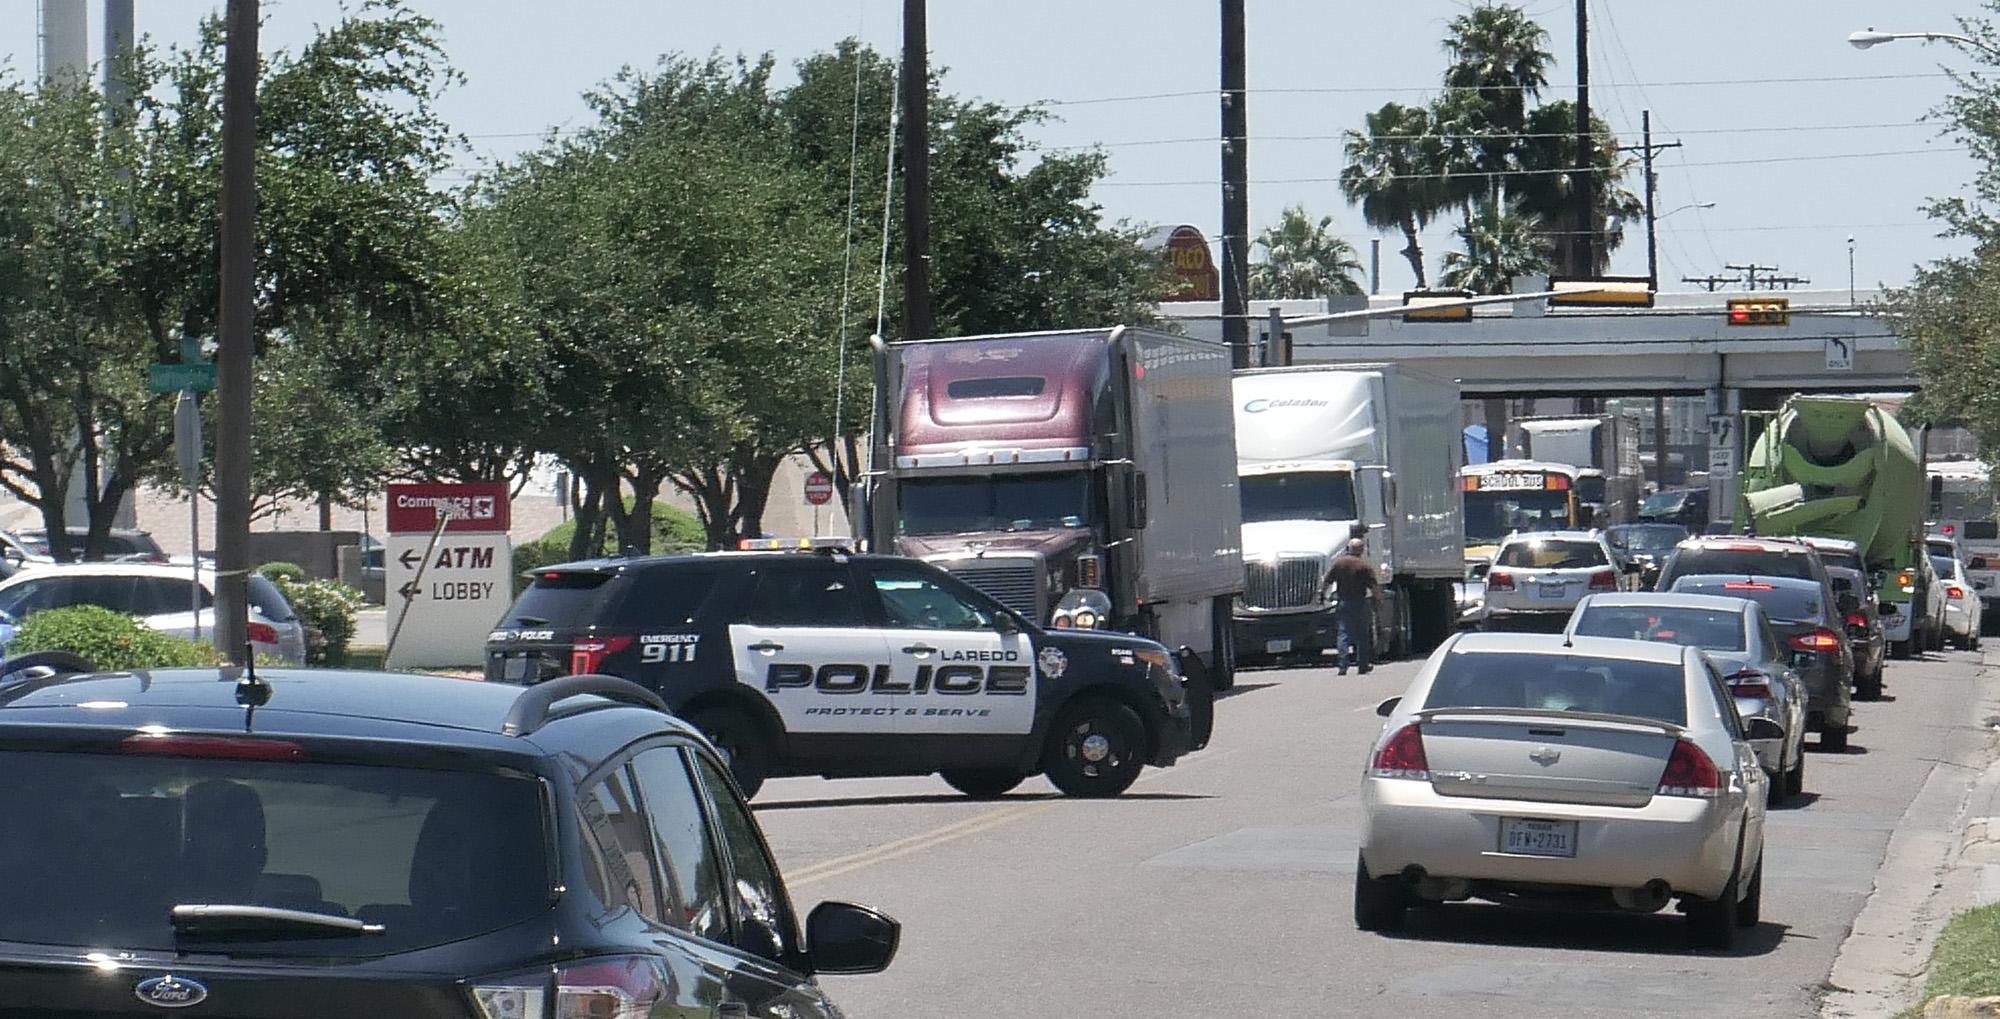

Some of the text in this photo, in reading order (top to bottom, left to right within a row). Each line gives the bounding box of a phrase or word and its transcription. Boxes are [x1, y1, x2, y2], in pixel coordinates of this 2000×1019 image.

[1481, 475, 1543, 488] SCHOOL BUS
[397, 495, 471, 508] Commce
[434, 547, 495, 569] ATM
[432, 582, 494, 600] LOBBY
[520, 630, 555, 641] POLICE
[640, 634, 700, 644] EMERGENCY
[641, 643, 697, 664] 911
[941, 650, 1018, 662] LAREDO
[766, 663, 1032, 696] POLICE
[805, 707, 991, 717] PROTECT & SERVE
[151, 981, 190, 1000] Ford
